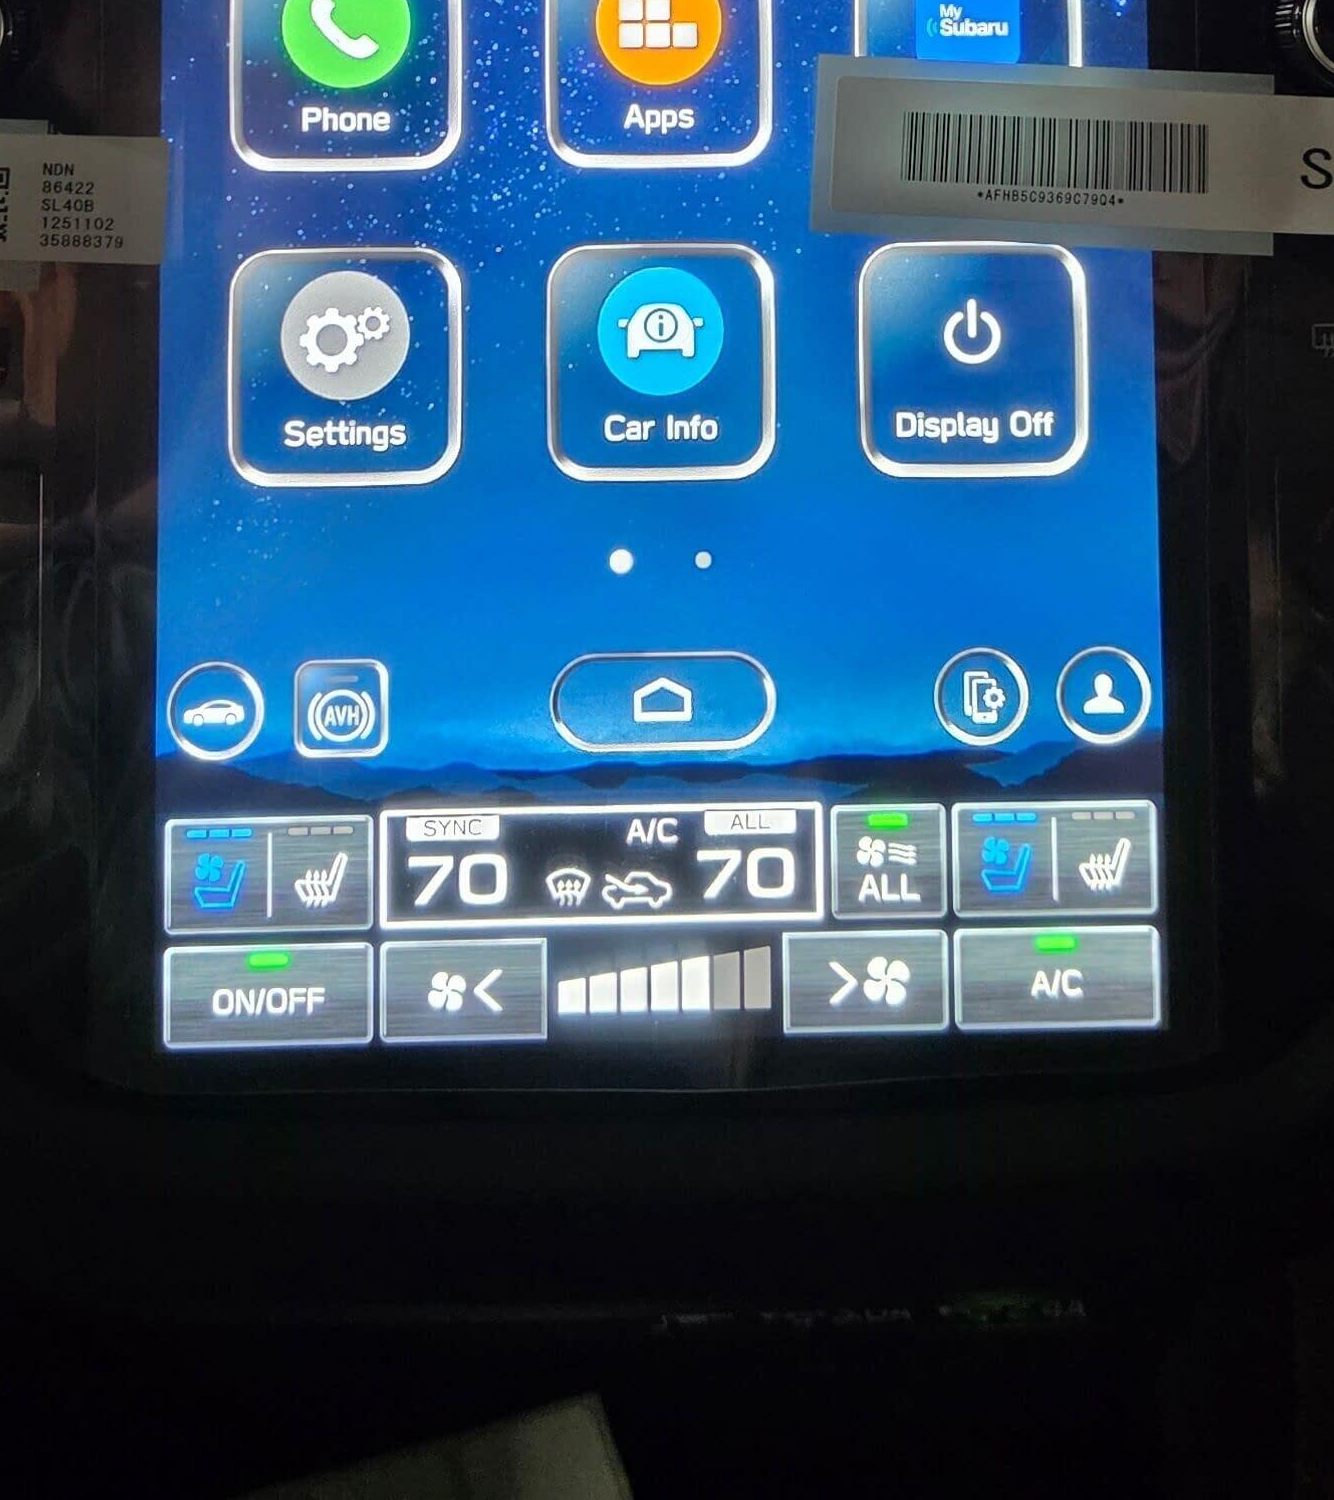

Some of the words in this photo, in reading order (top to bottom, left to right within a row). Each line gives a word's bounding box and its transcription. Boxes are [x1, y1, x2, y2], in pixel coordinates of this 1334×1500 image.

[938, 3, 964, 21] My
[938, 18, 1009, 37] Subaru
[300, 105, 391, 133] Phone
[622, 103, 695, 134] Apps
[42, 162, 75, 176] NDN
[1300, 147, 1334, 190] S
[41, 180, 95, 195] 86422
[41, 216, 115, 231] 1251102
[38, 233, 125, 249] 35888379
[283, 417, 408, 453] Settings
[603, 412, 655, 442] Car
[666, 412, 719, 442] Info
[894, 410, 999, 444] Display
[1010, 409, 1055, 439] Off
[323, 704, 360, 727] AVH
[423, 819, 483, 837] SYNC
[625, 817, 679, 845] A/C
[729, 813, 771, 831] ALL
[407, 852, 509, 906] 70
[695, 847, 797, 900] 70
[857, 873, 922, 903] ALL
[1030, 969, 1083, 998] A/C
[211, 986, 326, 1017] ON/OFF
